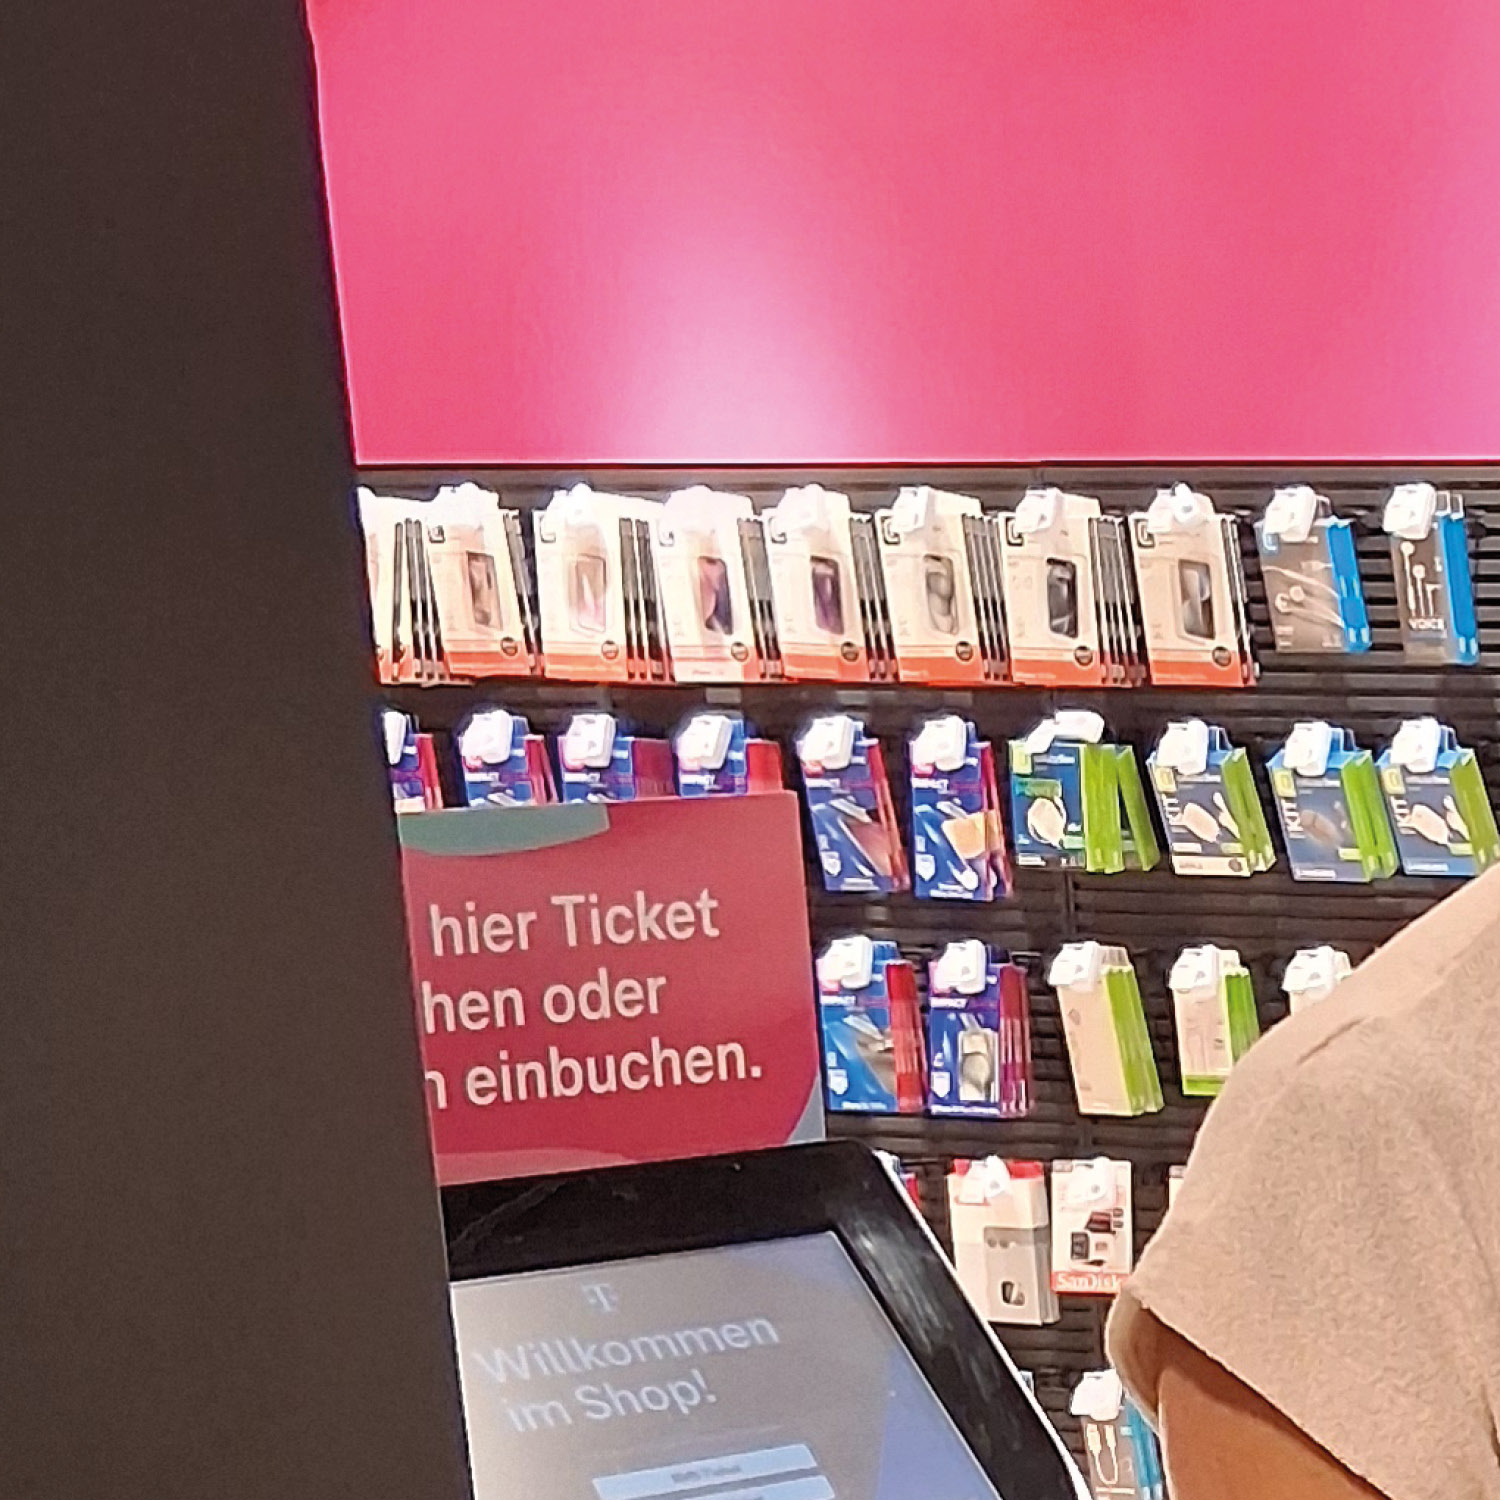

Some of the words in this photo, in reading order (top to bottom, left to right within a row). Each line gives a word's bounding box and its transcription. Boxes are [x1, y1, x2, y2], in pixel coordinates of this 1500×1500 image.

[430, 901, 537, 956] hier
[551, 888, 720, 947] Ticket
[543, 967, 666, 1024] oder
[465, 1036, 763, 1106] einbuchen.
[1056, 1273, 1123, 1291] SanDisk
[472, 1317, 782, 1384] Willkommen
[502, 1399, 573, 1432] im
[574, 1367, 718, 1420] Shop!
